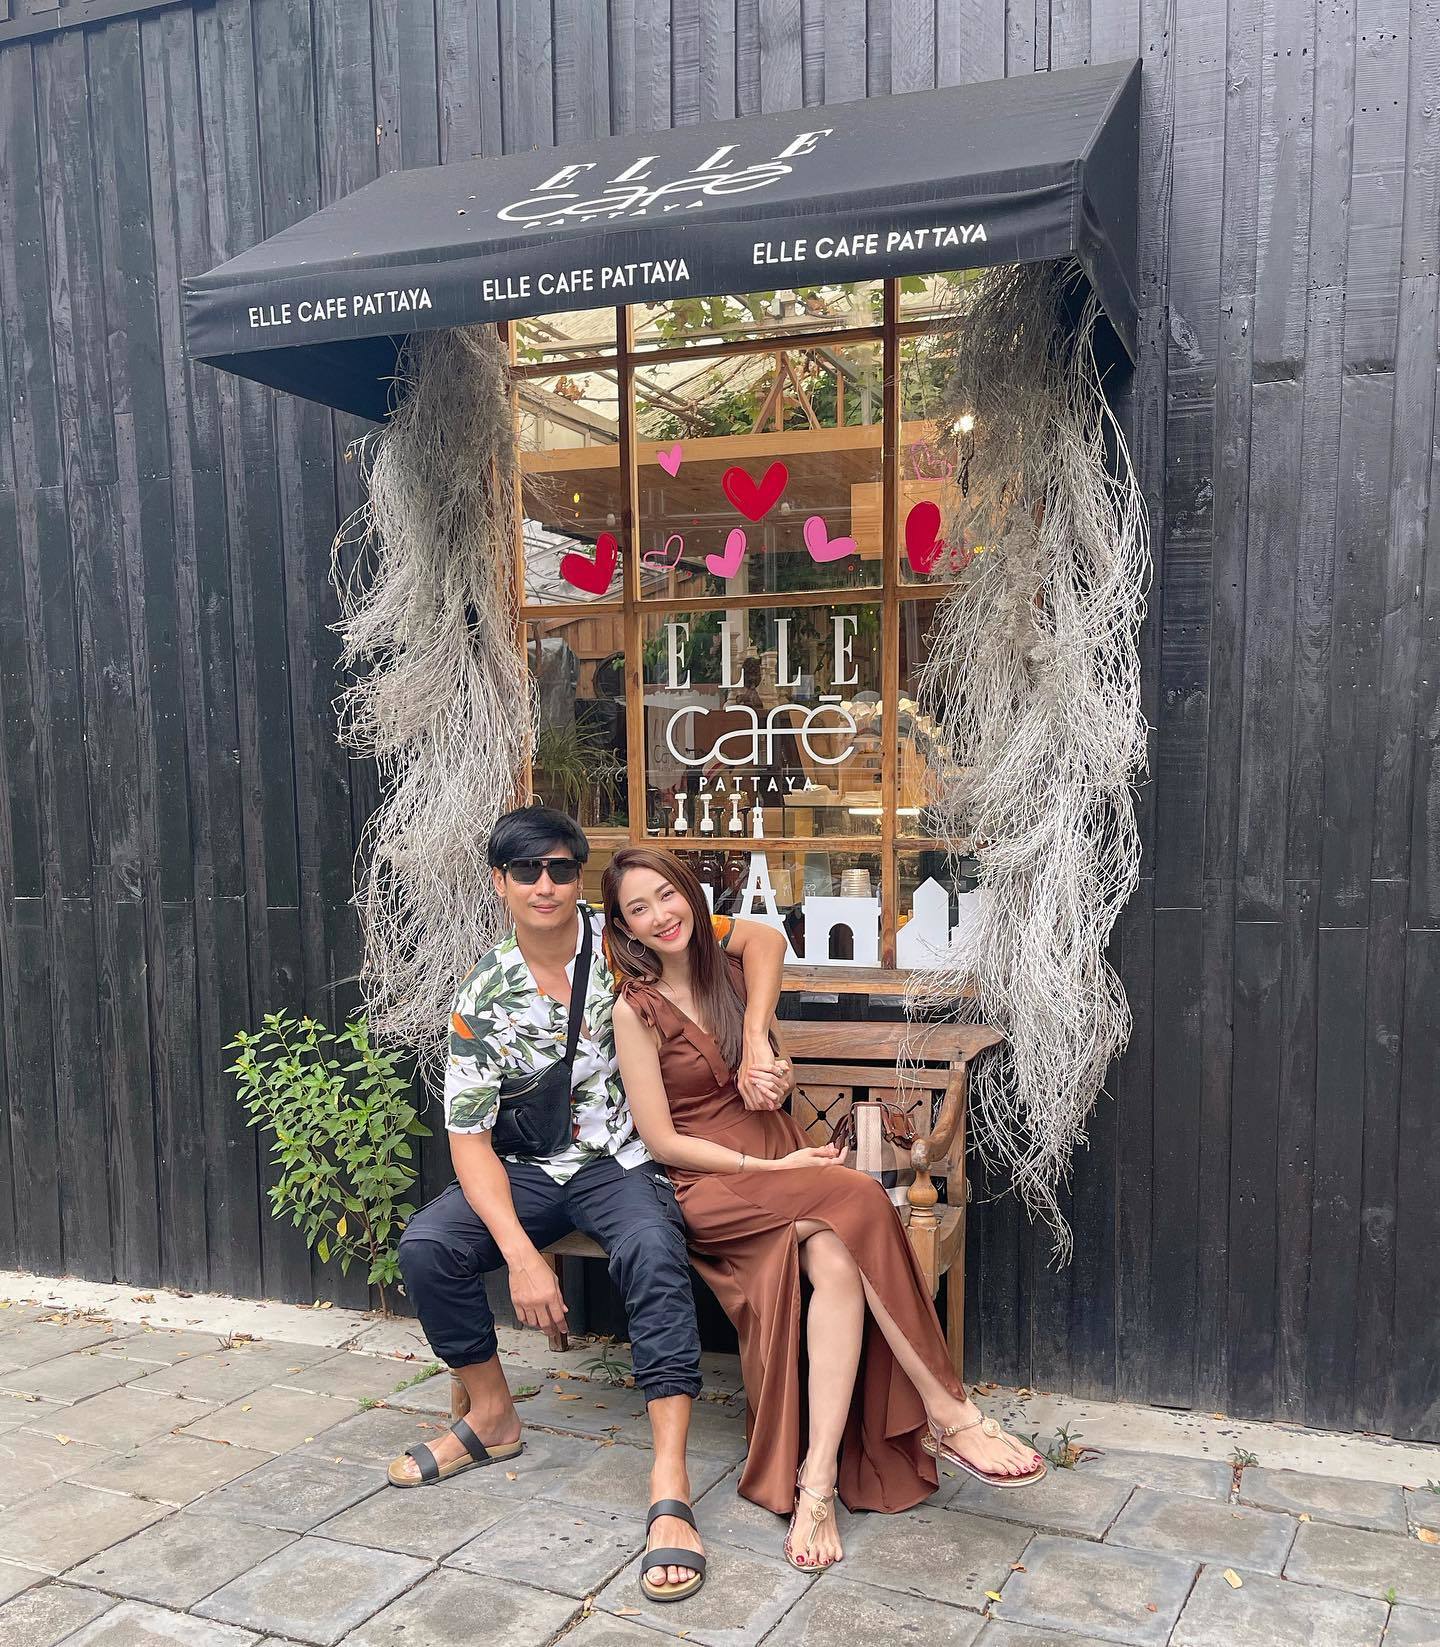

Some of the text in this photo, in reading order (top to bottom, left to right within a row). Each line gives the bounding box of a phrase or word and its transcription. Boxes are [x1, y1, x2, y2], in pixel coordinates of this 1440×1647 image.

[529, 128, 834, 192] ELLE
[753, 223, 988, 265] ELLE CAFE PATTAYA
[482, 258, 690, 302] ELLE CAFE PATTAYA
[248, 287, 433, 328] ELLE CAFE PATTAYA
[663, 614, 860, 690] ELLE
[699, 776, 815, 793] PATTAYA
